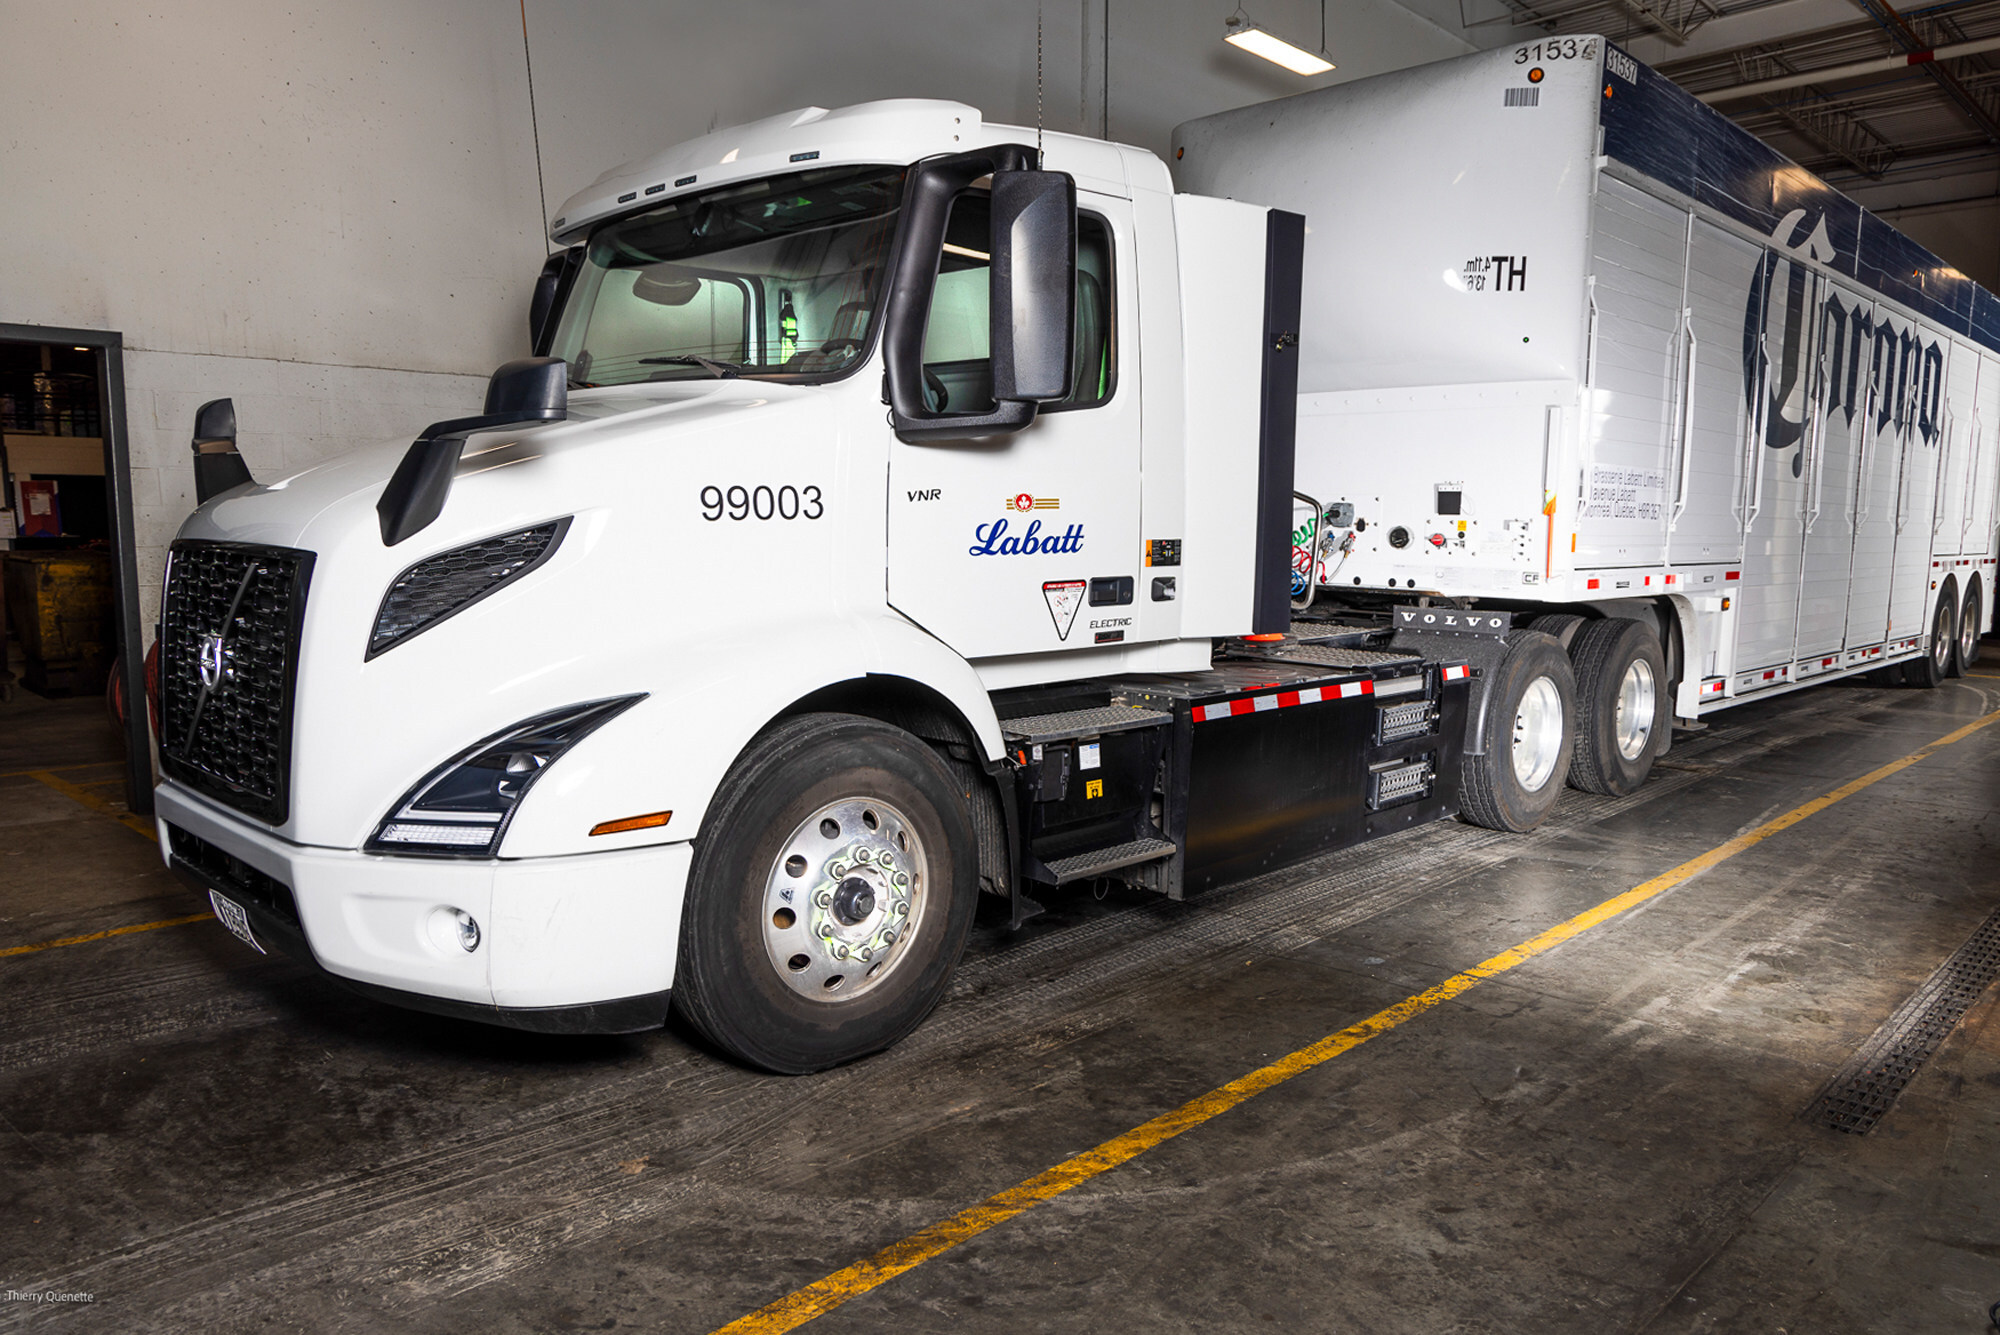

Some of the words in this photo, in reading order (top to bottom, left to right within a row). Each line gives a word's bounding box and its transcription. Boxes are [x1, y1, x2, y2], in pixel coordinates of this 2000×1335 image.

[1606, 49, 1636, 84] 31537
[700, 485, 824, 521] 99003
[907, 489, 941, 502] VNR
[969, 518, 1084, 556] Labatt
[1089, 617, 1132, 629] ELECTRIC
[1401, 611, 1502, 628] VOLVO
